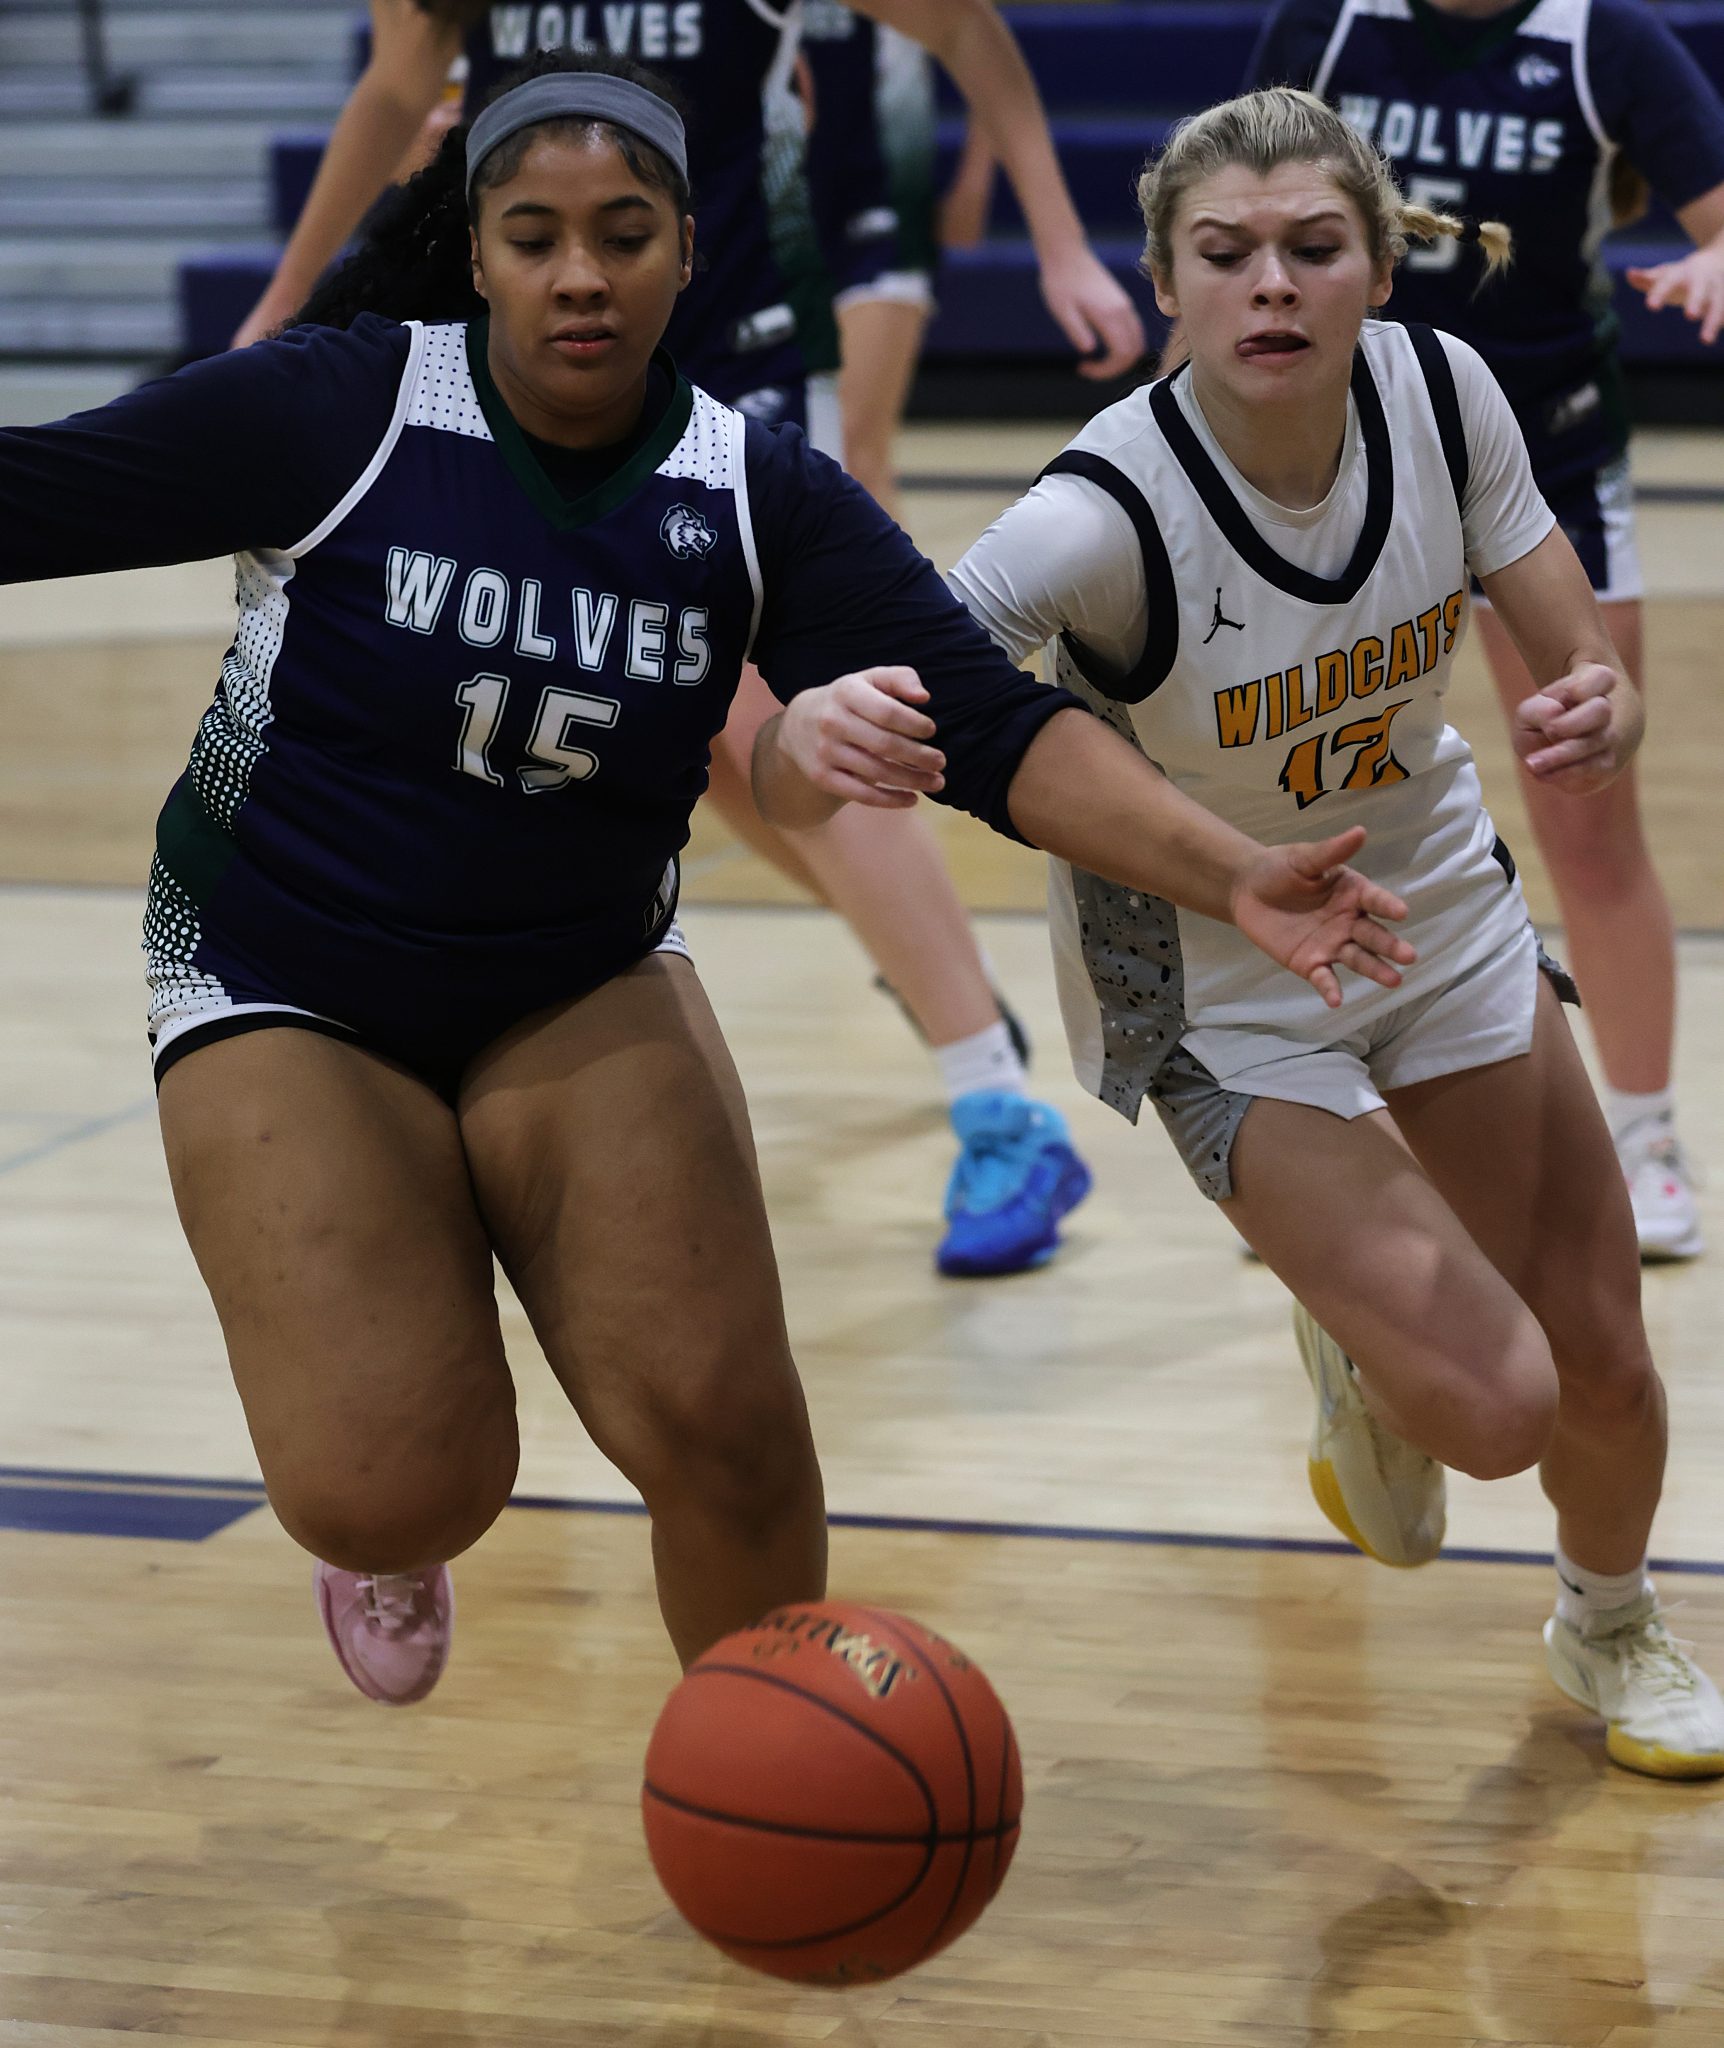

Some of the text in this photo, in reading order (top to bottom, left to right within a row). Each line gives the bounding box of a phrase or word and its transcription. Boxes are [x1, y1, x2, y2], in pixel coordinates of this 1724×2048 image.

[489, 2, 702, 58] WOLVES
[1340, 94, 1563, 173] WOLVES
[385, 546, 712, 686] WOLVES
[1213, 589, 1464, 749] WILDCATS
[451, 672, 621, 794] 15
[1277, 698, 1414, 811] 12
